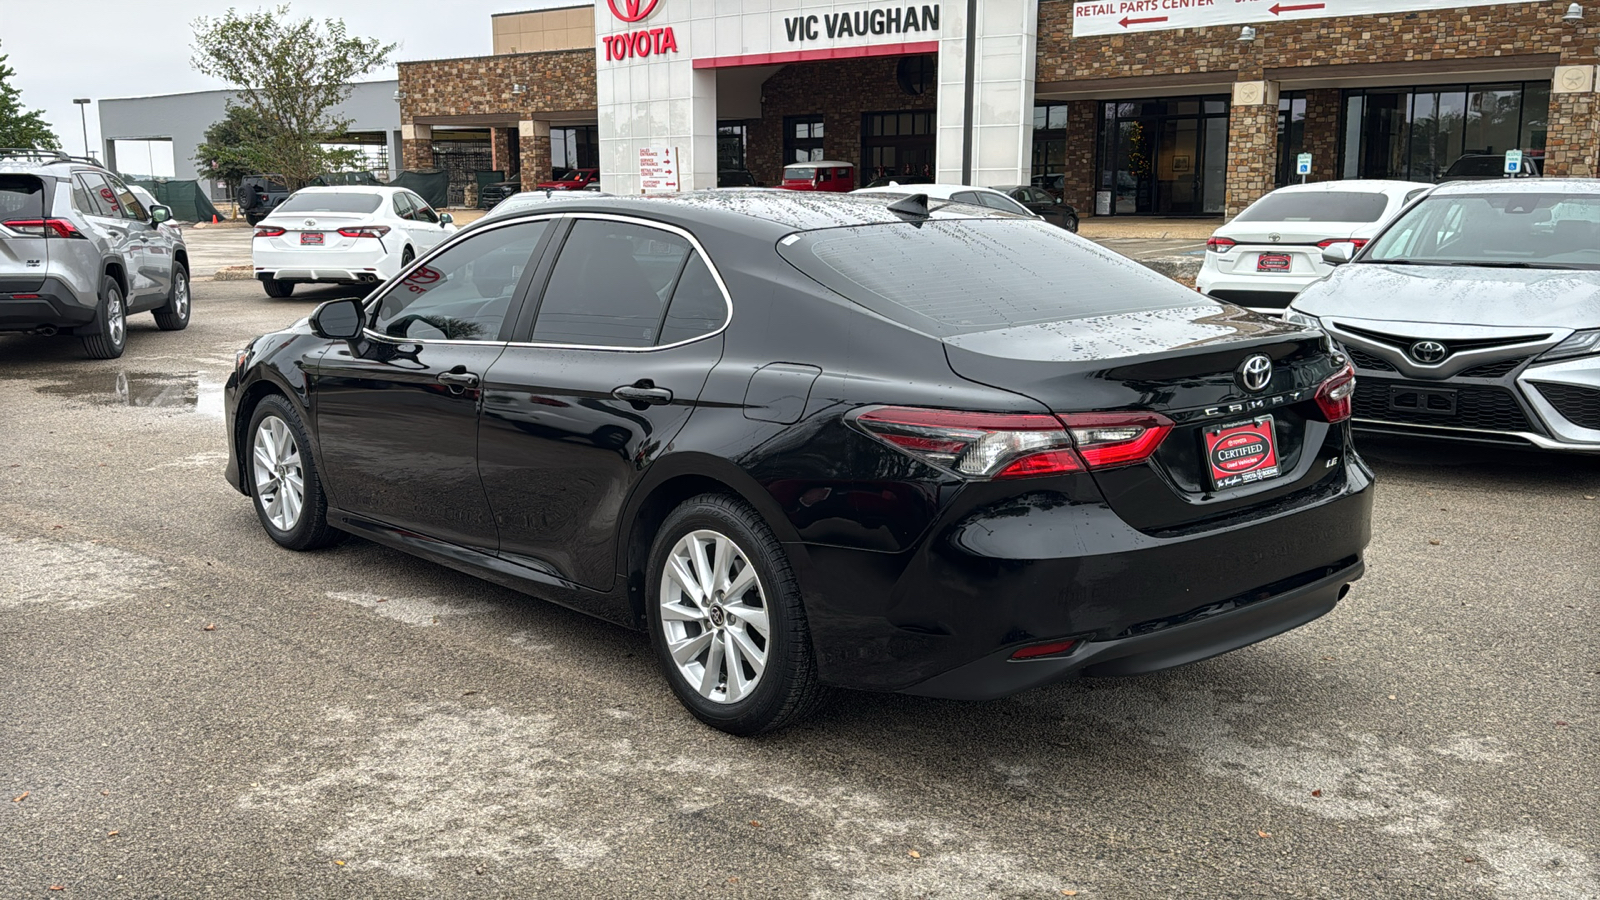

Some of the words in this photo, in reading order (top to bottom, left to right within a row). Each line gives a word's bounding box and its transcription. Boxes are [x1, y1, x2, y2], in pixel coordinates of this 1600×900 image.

[1076, 3, 1116, 17] RETAIL
[1119, 0, 1158, 13] PARTS
[784, 15, 818, 42] VIC
[824, 4, 939, 39] VAUGHAN
[603, 27, 678, 62] TOYOTA
[1204, 391, 1300, 416] CAMRY
[1218, 444, 1262, 461] CERTIFIED
[1238, 458, 1258, 466] Vehicles
[1326, 456, 1338, 468] LE
